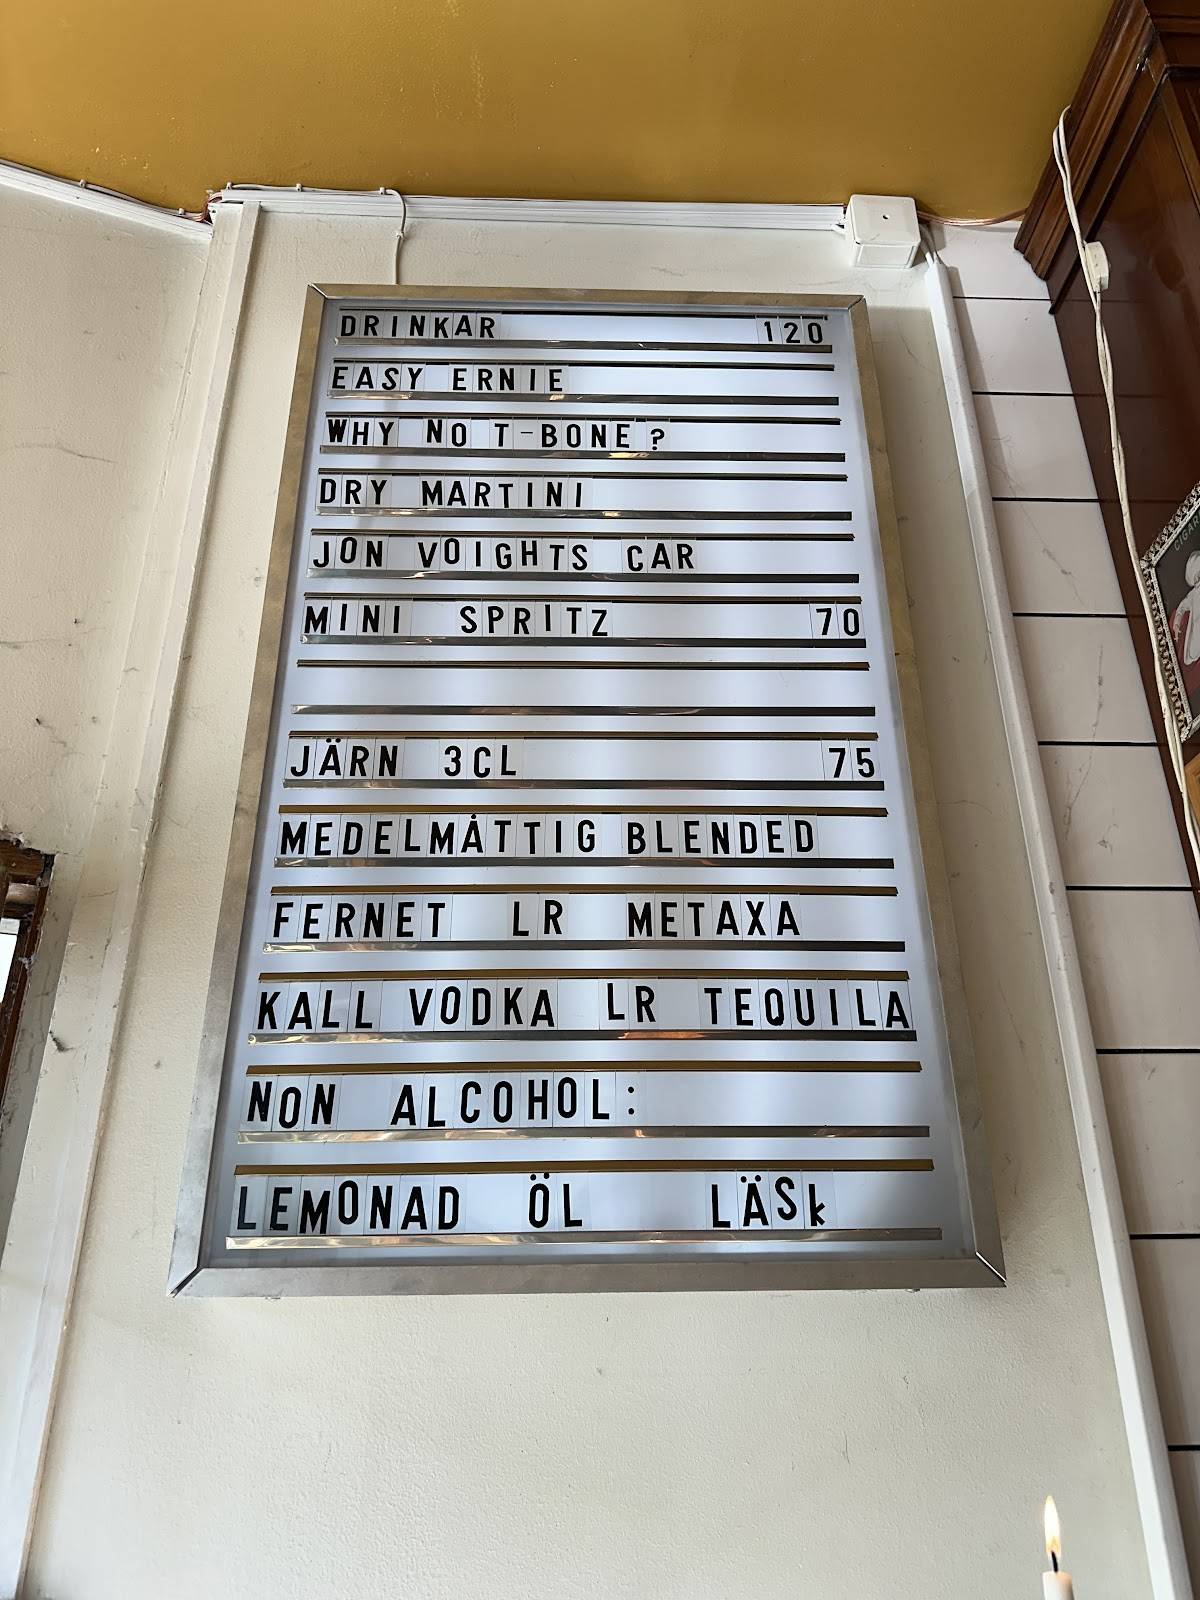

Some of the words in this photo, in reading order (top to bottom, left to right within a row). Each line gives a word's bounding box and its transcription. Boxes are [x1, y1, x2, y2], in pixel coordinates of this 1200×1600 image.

[340, 315, 495, 338] DRINKAR
[764, 321, 823, 344] 120
[332, 366, 423, 390] EASY
[453, 368, 562, 391] ERNIE
[328, 419, 394, 445] WHY
[427, 419, 466, 447] NO
[320, 479, 387, 505] DRY
[422, 481, 581, 508] MARTINI
[313, 537, 382, 567] JON
[418, 538, 587, 570] VOIGHTS
[627, 543, 693, 571] CAR
[304, 604, 400, 636] MINI
[460, 605, 607, 636] SPRITZ
[816, 608, 859, 636] 70
[291, 736, 398, 776] JÄRN
[445, 745, 516, 778] 3CL
[829, 748, 874, 778] 75
[281, 814, 595, 856] MEDELMÅTTIG
[628, 820, 813, 854] BLENDED
[273, 902, 445, 939] FERNET
[513, 900, 562, 936] LR
[628, 901, 800, 937] METAXA
[258, 990, 372, 1029] KALL
[409, 986, 554, 1027] VODKA
[608, 983, 656, 1022] LR
[704, 988, 909, 1028] TEQUILA
[247, 1081, 335, 1128] NON
[391, 1077, 634, 1127] ALCOHOL:
[237, 1180, 459, 1234] LEMONAD
[529, 1174, 582, 1228] ÖL
